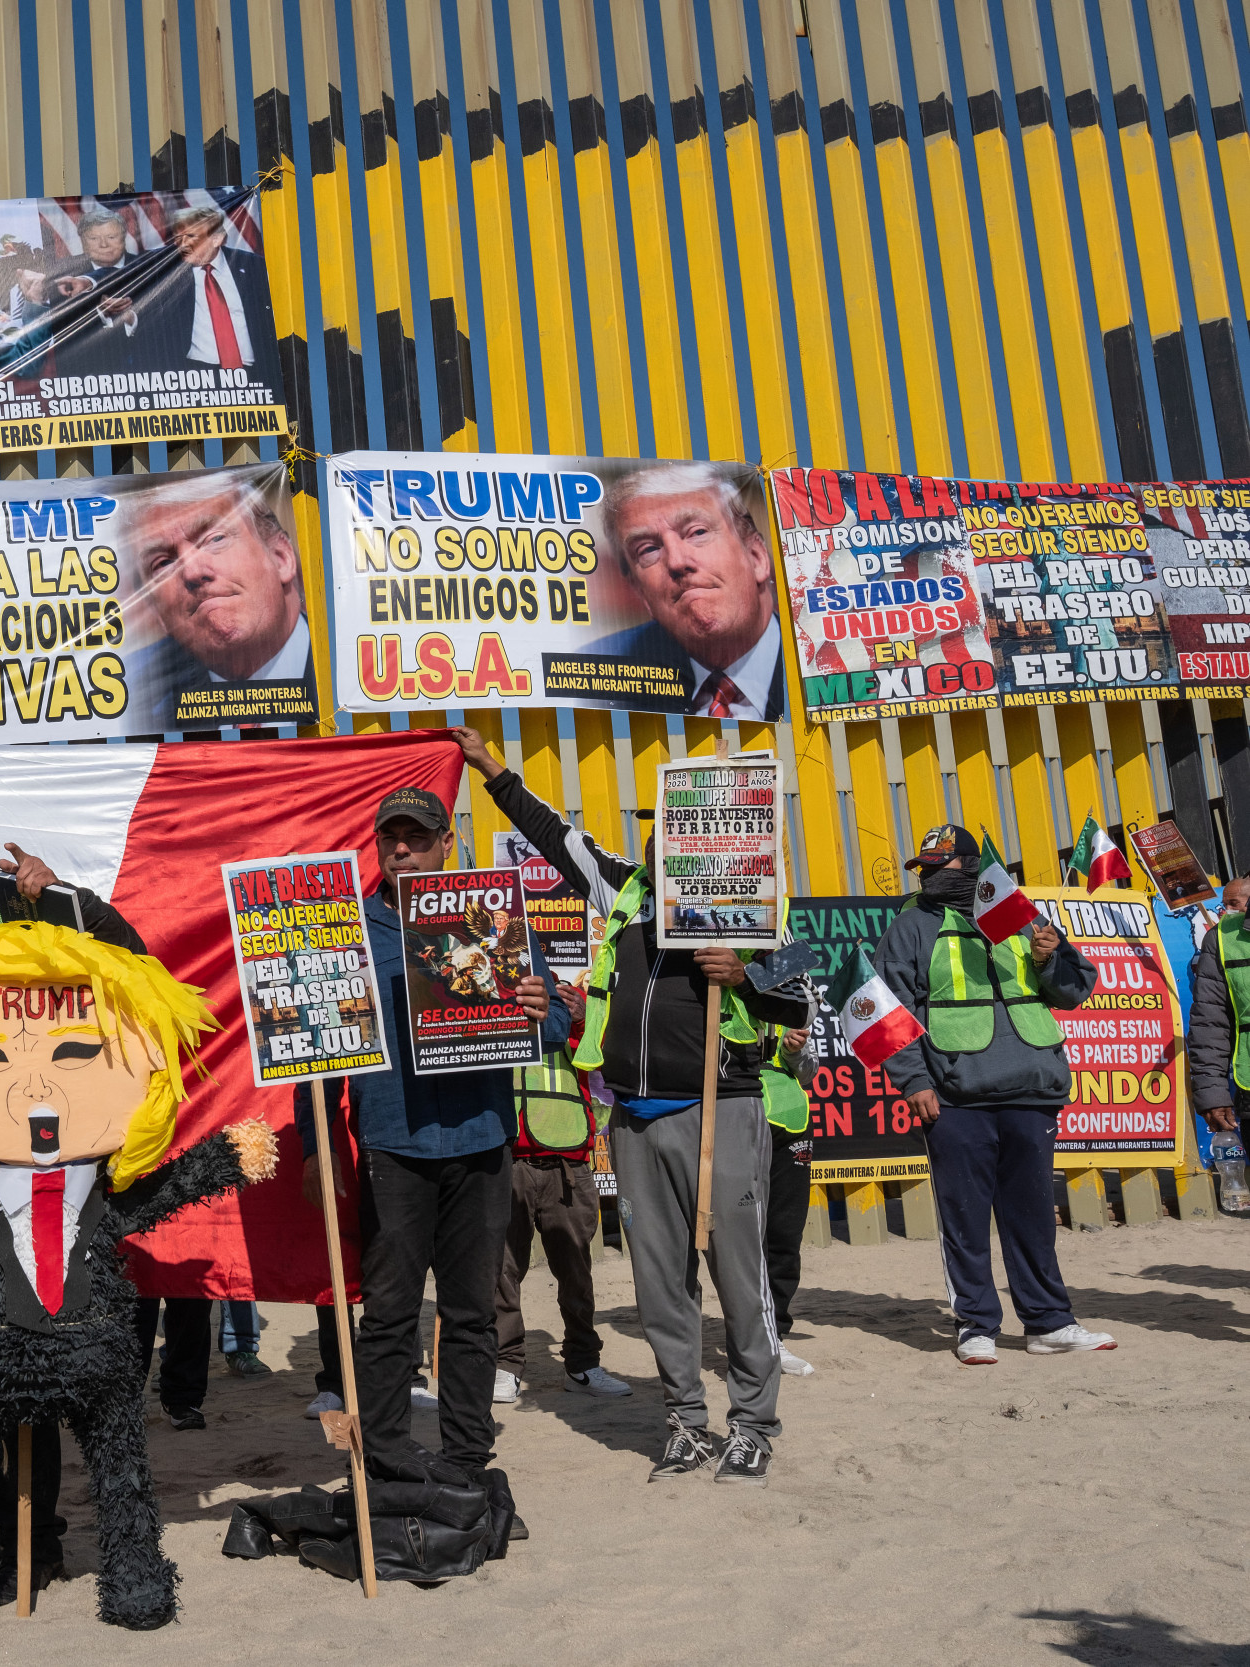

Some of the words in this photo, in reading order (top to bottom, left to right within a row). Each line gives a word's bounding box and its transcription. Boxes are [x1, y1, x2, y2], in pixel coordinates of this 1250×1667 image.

[40, 370, 216, 398] SUBORDINACION
[219, 367, 264, 389] NO...
[49, 394, 137, 417] SOBERANO
[154, 389, 275, 409] INDEPENDIENTE
[335, 469, 603, 524] TRUMP
[771, 467, 847, 530] NO
[851, 471, 892, 521] A
[884, 474, 960, 519] LA
[1142, 488, 1219, 508] SEGUIR
[962, 505, 1000, 530] NO
[1005, 501, 1141, 529] QUEREMOS
[354, 526, 422, 574] NO
[435, 527, 598, 576] SOMOS
[784, 519, 964, 556] INTROMISION
[969, 530, 1061, 559] SEGUIR
[1061, 527, 1149, 555] SIENDO
[27, 547, 120, 597] LAS
[856, 551, 905, 577] DE
[989, 560, 1038, 589] EL
[1044, 556, 1146, 587] PATIO
[369, 574, 540, 624] ENEMIGOS
[546, 576, 591, 625] DE
[806, 575, 966, 614] ESTADOS
[993, 589, 1156, 623] TRASERO
[821, 605, 963, 642] UNIDOS
[1063, 624, 1101, 646] DE
[873, 640, 918, 664] EN
[357, 632, 533, 701] U.S.A.
[1010, 648, 1163, 687] EE.UU.
[802, 660, 996, 708] MEXICO
[668, 780, 687, 789] 2020
[669, 773, 687, 783] 1848
[691, 770, 735, 788] TRATADO
[754, 771, 770, 779] 172
[666, 790, 726, 807] GUADALUPE
[729, 788, 773, 806] HIDALGO
[666, 809, 698, 821] ROBO
[701, 809, 716, 820] DE
[719, 808, 774, 820] NUESTRO
[666, 821, 774, 834] TERRITORIO
[665, 855, 722, 877] MEXICANO
[723, 855, 774, 877] PATRIOTA
[232, 870, 274, 911] ¡YA
[274, 862, 356, 902] BASTA!
[411, 872, 514, 892] MEXICANOS
[681, 885, 699, 896] LO
[702, 885, 757, 895] ROBADO
[236, 911, 264, 934] NO
[268, 901, 360, 930] QUEREMOS
[409, 887, 513, 922] ¡GRITO!
[417, 916, 430, 925] DE
[430, 914, 465, 925] GUERRA
[1065, 901, 1152, 939] TRUMP
[240, 931, 307, 958] SEGUIR
[308, 924, 364, 949] SIENDO
[1081, 945, 1154, 959] ENEMIGOS
[255, 958, 289, 983] EL
[295, 949, 361, 978] PATIO
[1098, 963, 1153, 990] U.U.
[256, 976, 366, 1010] TRASERO
[1081, 994, 1163, 1011] AMIGOS!
[306, 1007, 330, 1026] DE
[444, 1003, 525, 1021] CONVOCA
[268, 1024, 371, 1061] EE.UU.
[418, 1027, 453, 1036] DOMINGO
[468, 1023, 491, 1032] ENERO
[1121, 1019, 1162, 1039] ESTAN
[420, 1048, 454, 1056] ALIANZA
[456, 1043, 497, 1054] MIGRANTE
[498, 1040, 532, 1050] TIJUANA
[420, 1055, 461, 1066] ANGELES
[462, 1052, 477, 1063] SIN
[478, 1049, 532, 1061] FRONTERAS
[1085, 1045, 1140, 1064] PARTES
[1141, 1045, 1169, 1063] DEL
[1066, 1112, 1171, 1134] CONFUNDAS!
[1091, 1142, 1116, 1150] ALIANZA
[1117, 1141, 1150, 1149] MIGRANTES
[1152, 1140, 1175, 1149] TIJUANA
[837, 1166, 875, 1178] FRONTERAS
[880, 1165, 907, 1177] ALIANZA
